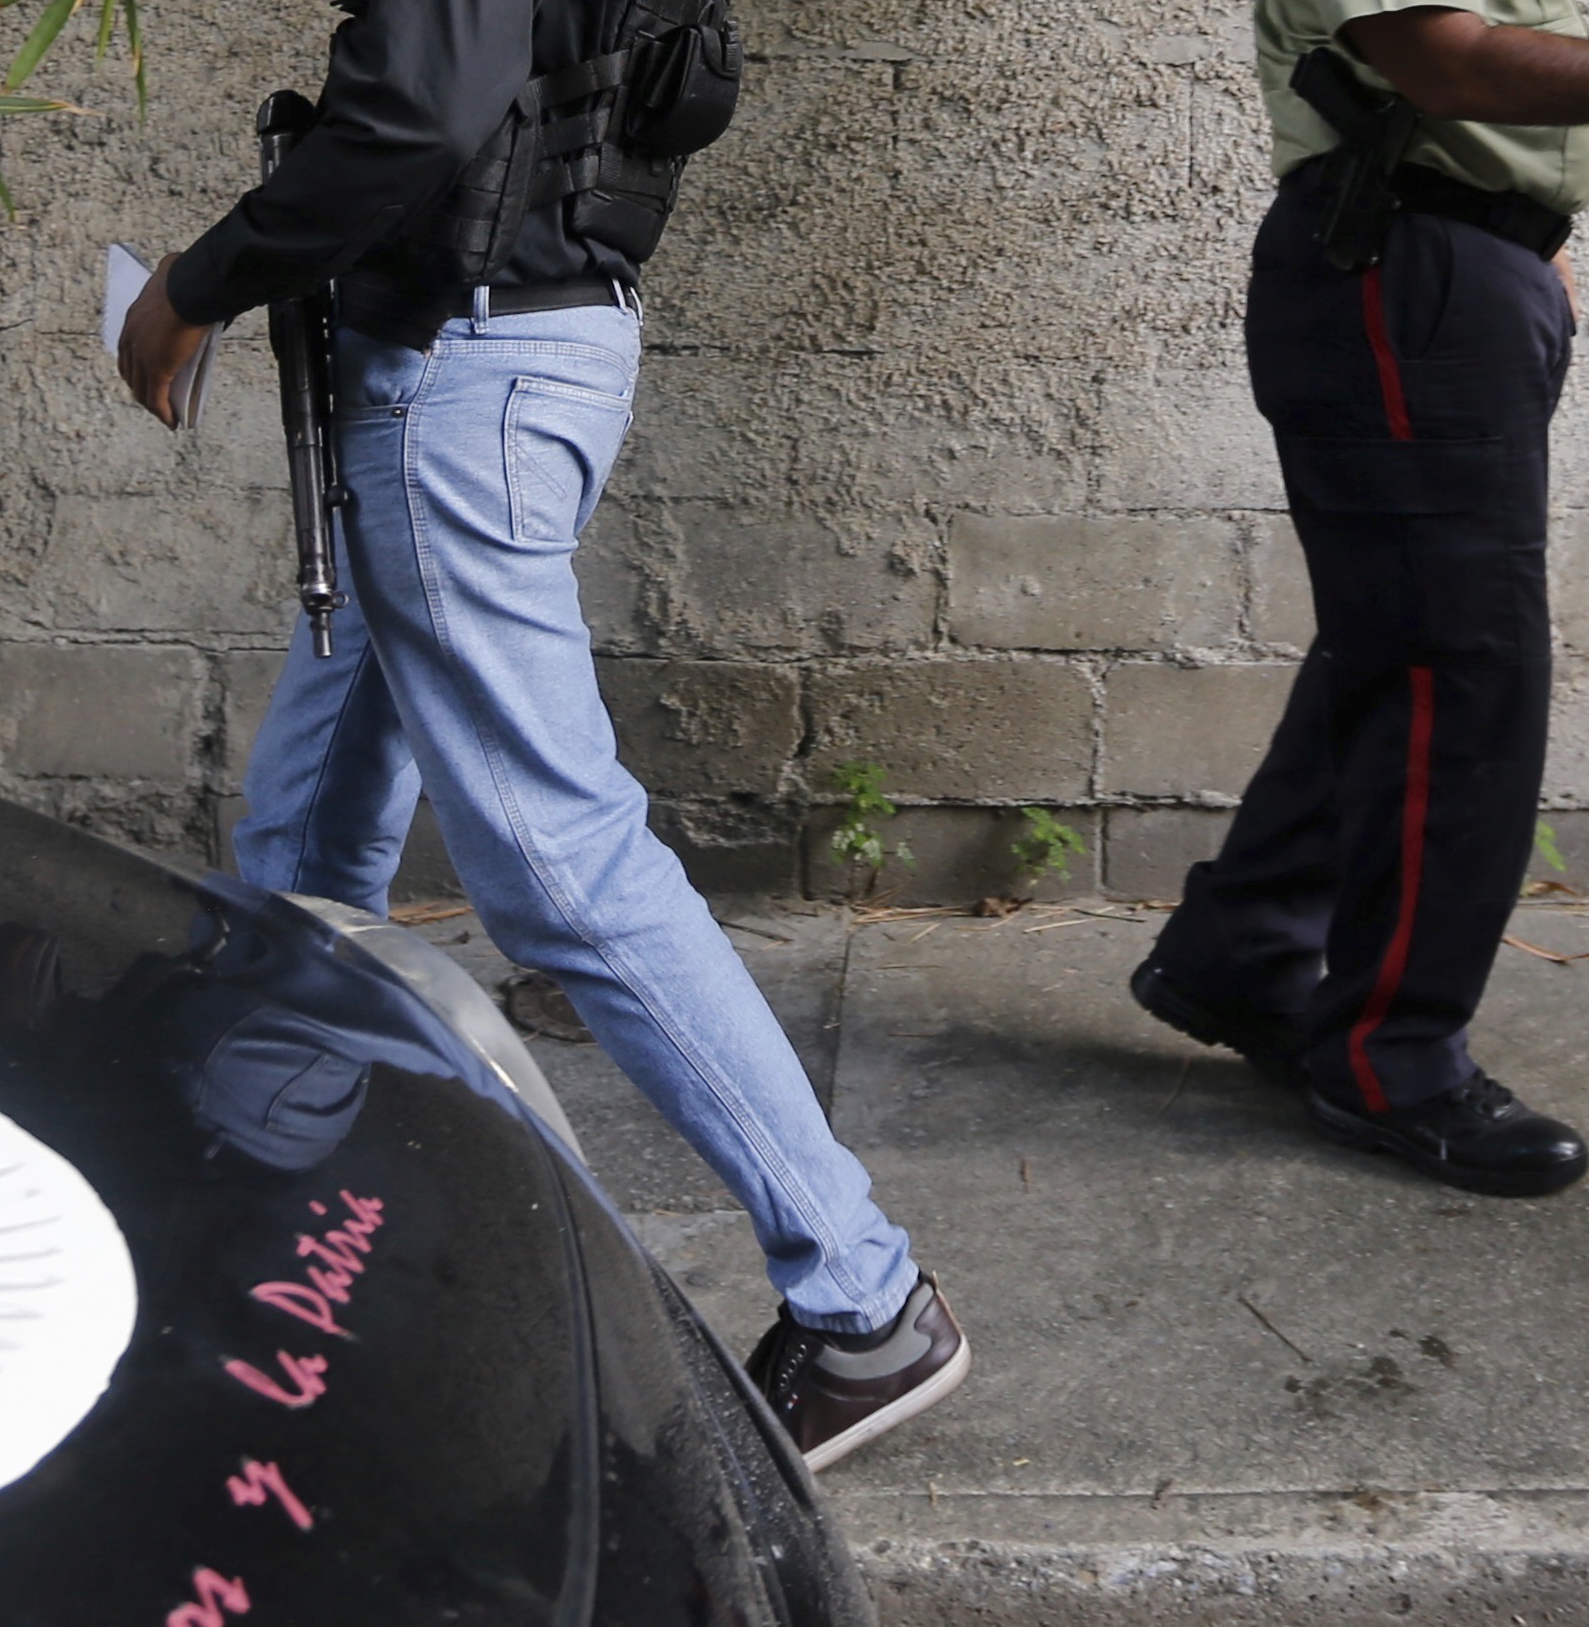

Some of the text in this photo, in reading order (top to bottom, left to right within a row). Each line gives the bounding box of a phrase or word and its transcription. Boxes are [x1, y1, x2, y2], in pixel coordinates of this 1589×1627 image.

[253, 1190, 385, 1339] Patria
[224, 1353, 329, 1407] la
[226, 1456, 314, 1530] y
